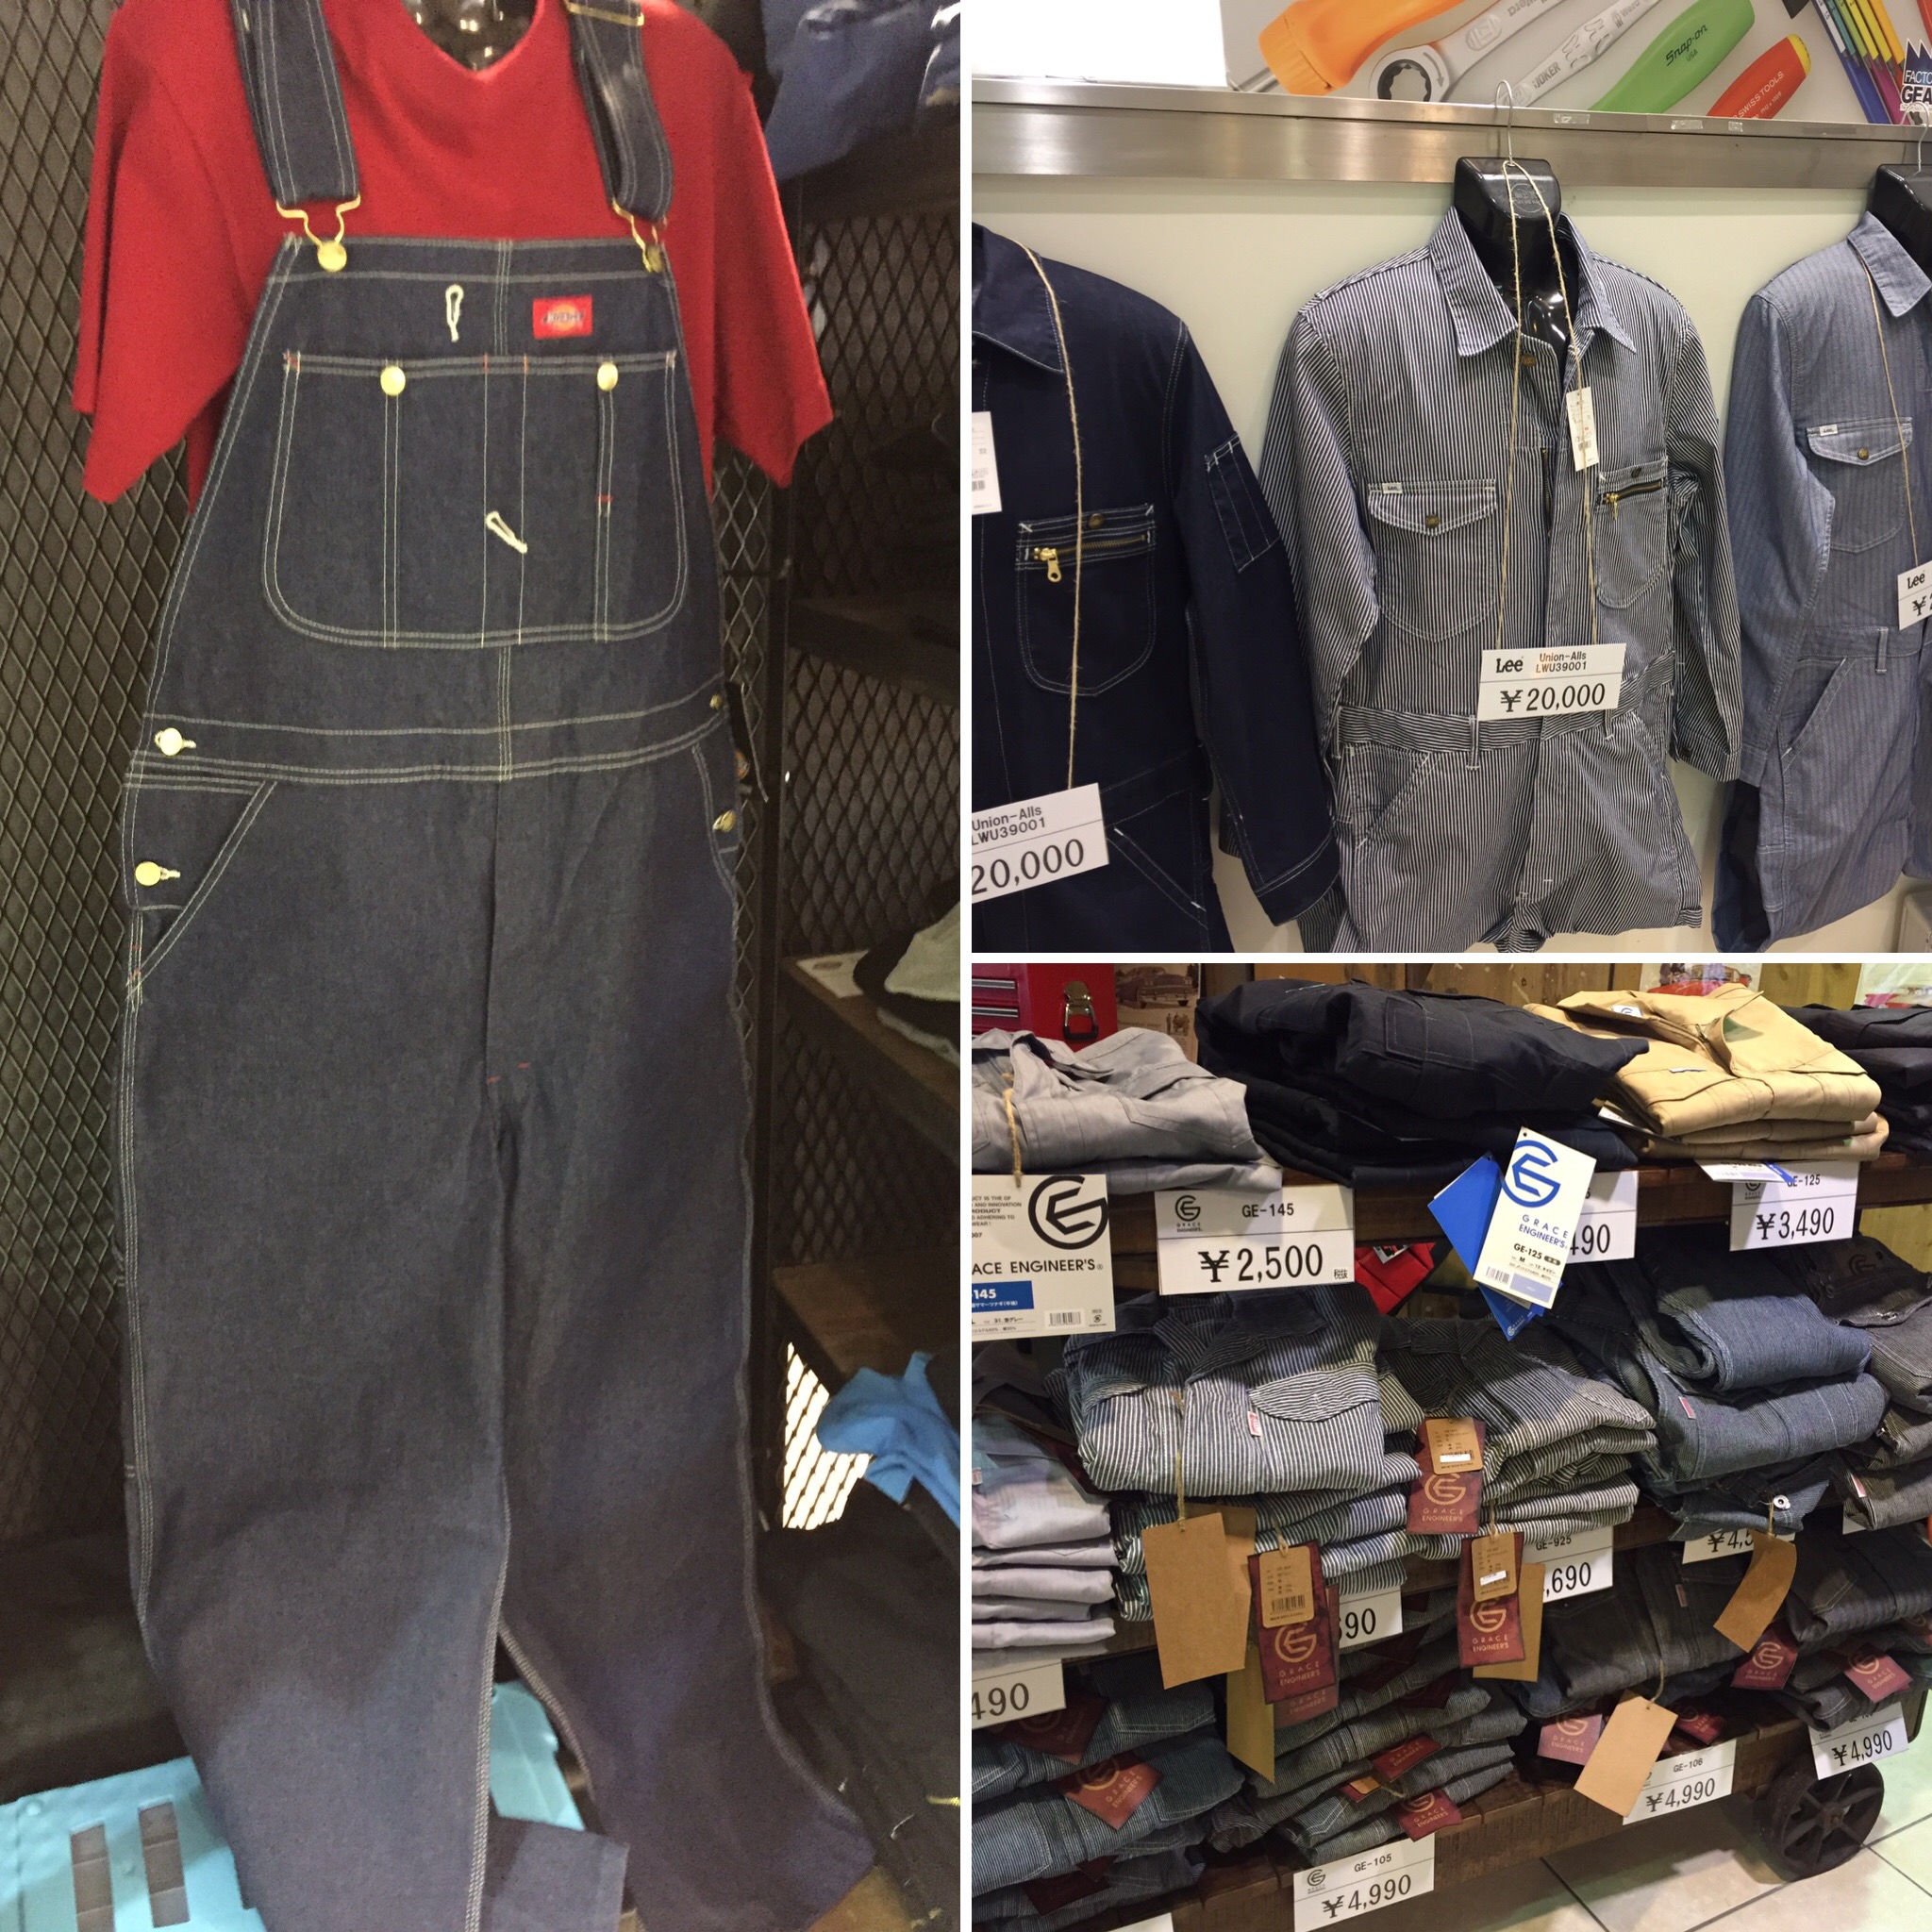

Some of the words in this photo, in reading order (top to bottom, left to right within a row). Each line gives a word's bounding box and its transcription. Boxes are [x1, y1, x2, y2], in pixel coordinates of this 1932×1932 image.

[1665, 25, 1708, 67] Snap-on
[1686, 49, 1699, 62] USA
[1534, 62, 1562, 89] JOKER
[1738, 93, 1761, 118] SWISS
[1759, 71, 1784, 95] TOOLS
[1907, 572, 1925, 590] Lee
[1496, 658, 1524, 674] Lee
[1540, 651, 1587, 662] Union-Alls
[1536, 661, 1587, 674] LWU39001
[972, 806, 1042, 832] Union-Alls
[972, 817, 1045, 845] LWU39001
[972, 839, 1084, 895] 20,000
[1241, 1203, 1294, 1218] GE-145
[1518, 1224, 1566, 1249] ENGINEER'S
[1522, 1214, 1569, 1239] GRACE
[1756, 1207, 1835, 1241] ¥3,490
[1513, 1242, 1542, 1259] GE-125
[1010, 1258, 1095, 1274] ENGINEER'S
[1536, 1535, 1572, 1551] GE-925
[1543, 1561, 1591, 1597] ,690
[1473, 1634, 1508, 1643] GRACE
[1831, 1730, 1892, 1767] ¥4,990
[1674, 1757, 1704, 1773] GE-106
[1645, 1777, 1715, 1812] ¥4,990
[1354, 1853, 1392, 1873] GE-105
[1322, 1874, 1412, 1919] ¥4,990
